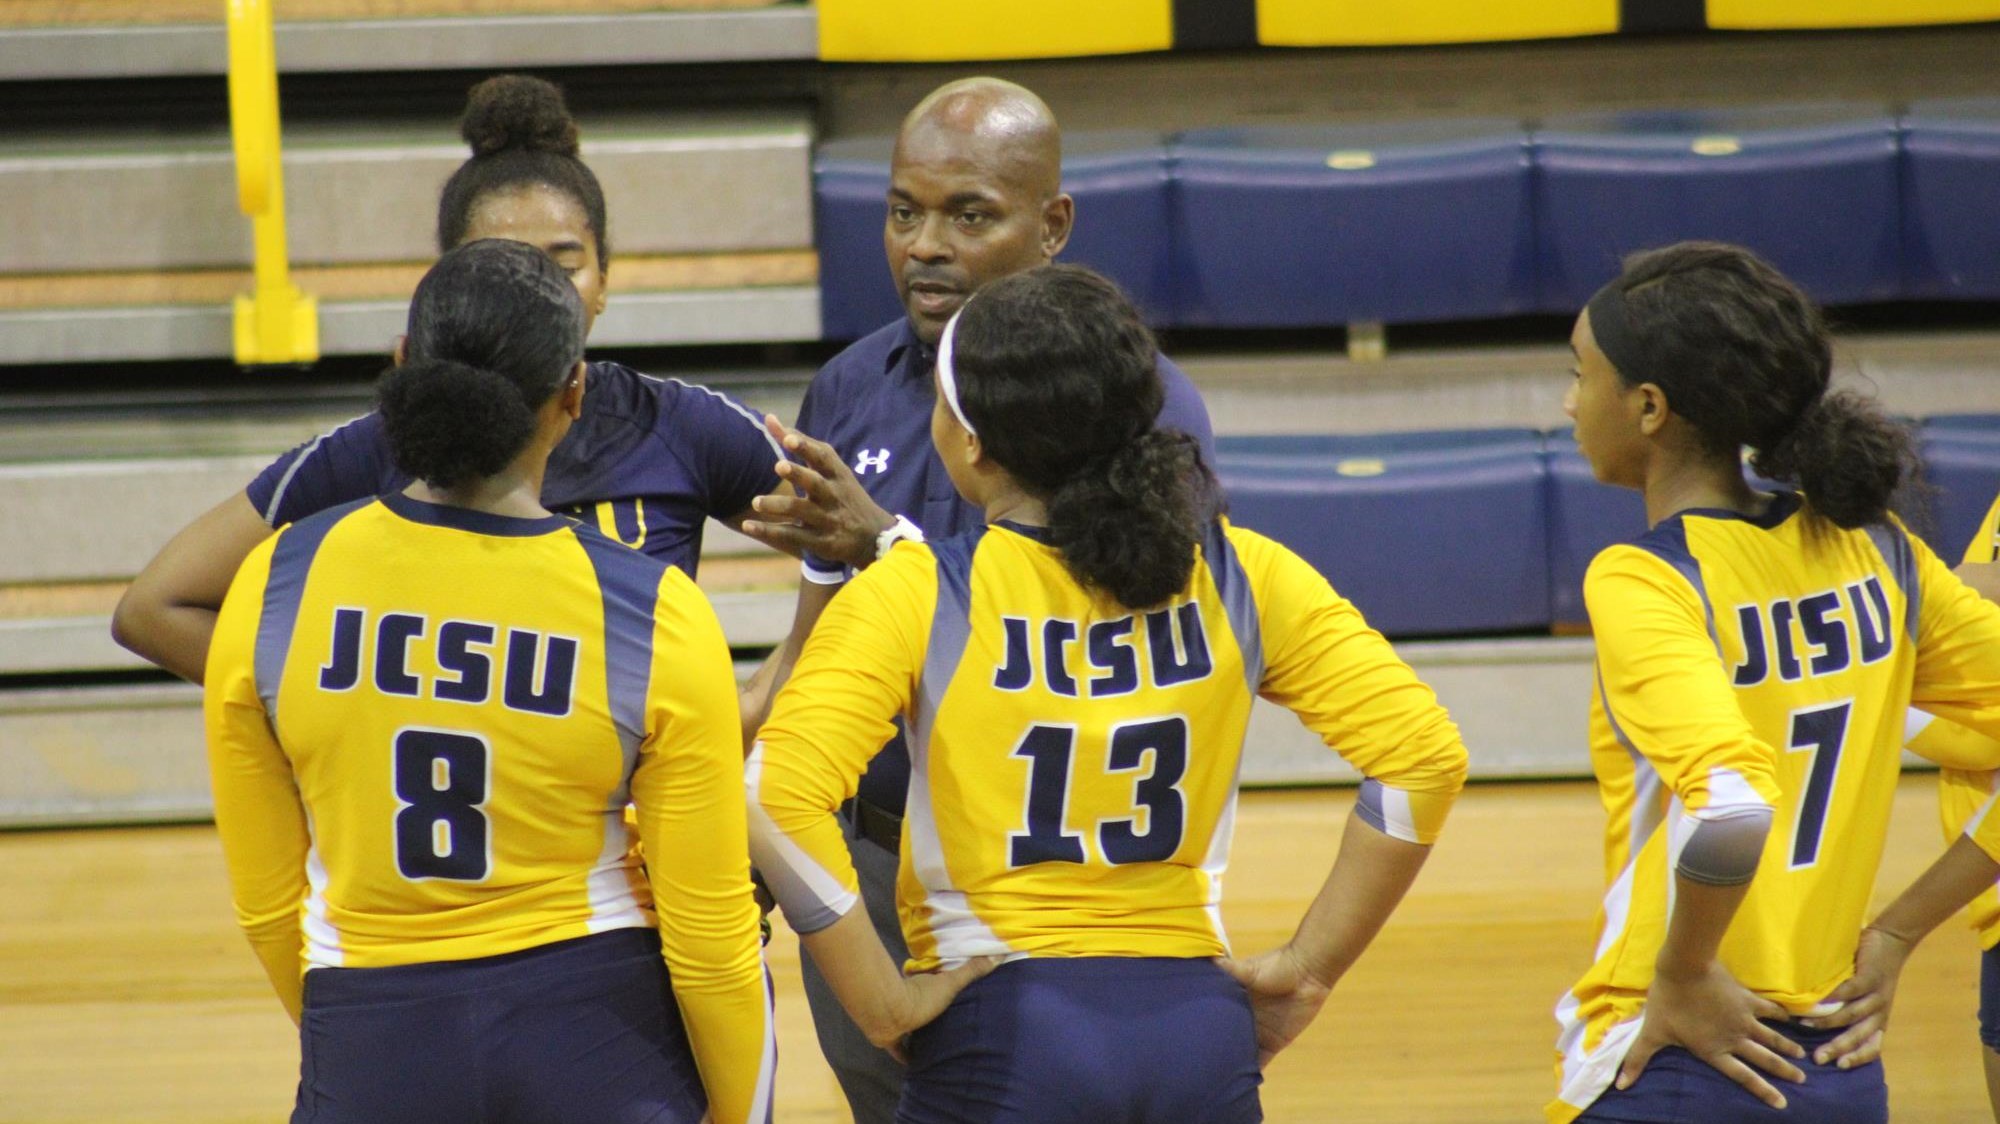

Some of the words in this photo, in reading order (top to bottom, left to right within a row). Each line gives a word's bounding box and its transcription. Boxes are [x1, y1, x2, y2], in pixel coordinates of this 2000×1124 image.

[318, 606, 580, 719] JCSU
[993, 598, 1213, 699] JCSU
[1733, 575, 1893, 687] JCSU
[392, 725, 493, 883] 8
[1008, 712, 1189, 870] 13
[1786, 697, 1854, 872] 7
